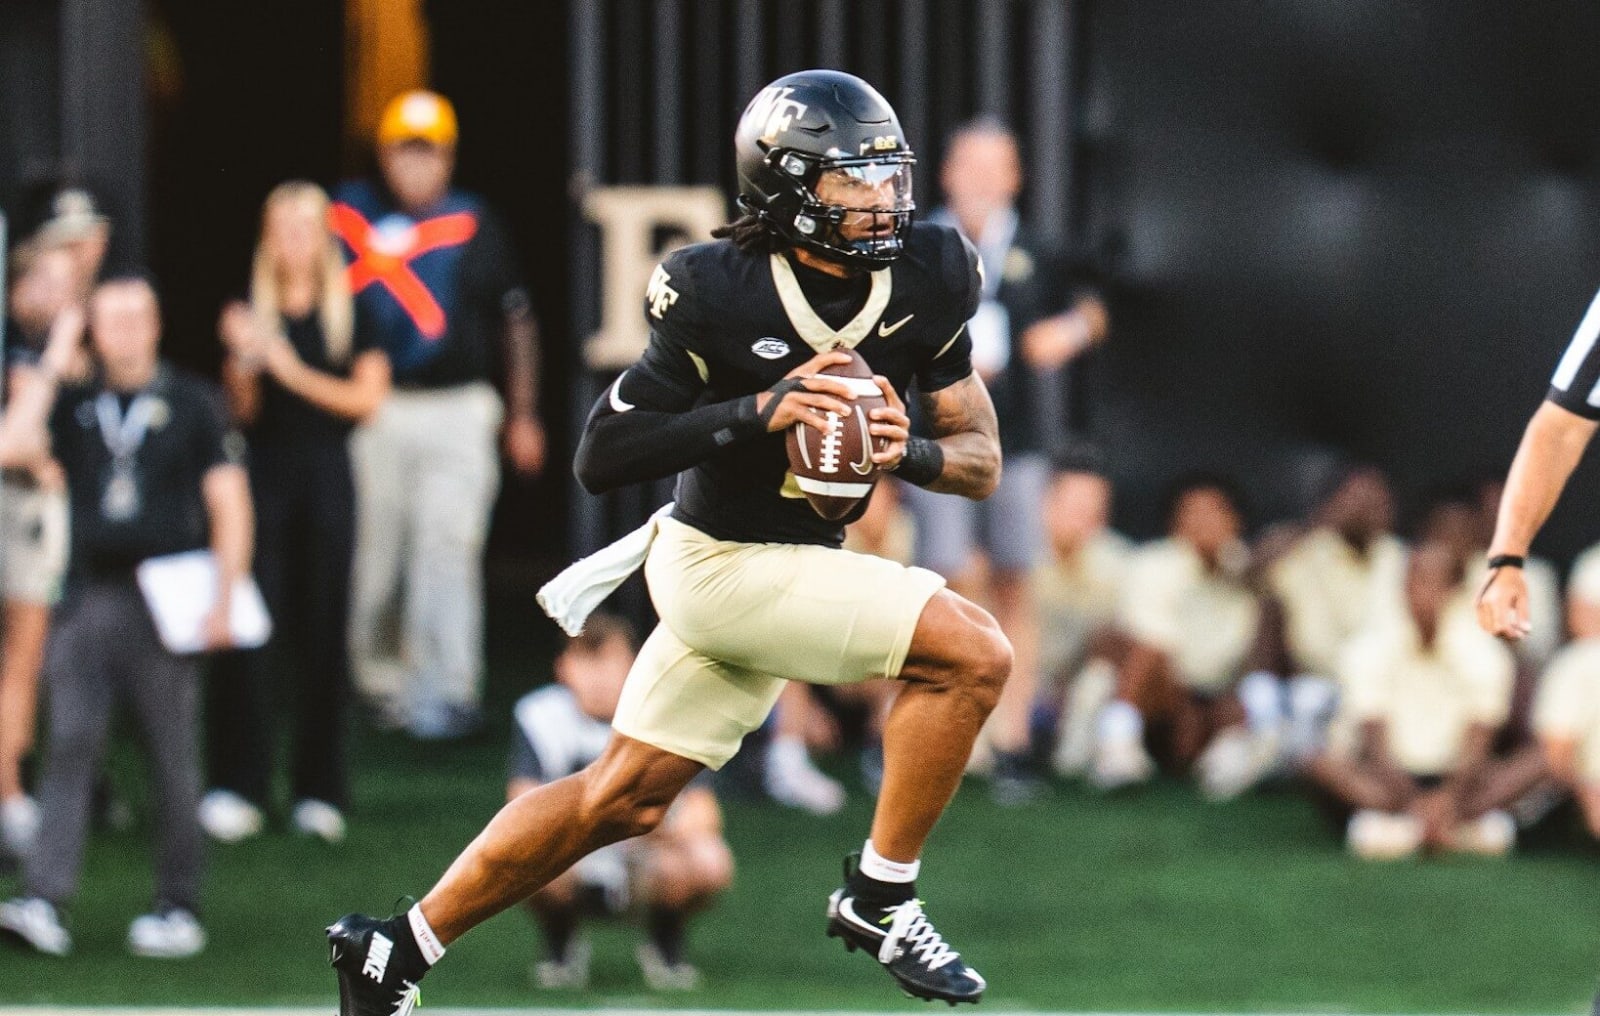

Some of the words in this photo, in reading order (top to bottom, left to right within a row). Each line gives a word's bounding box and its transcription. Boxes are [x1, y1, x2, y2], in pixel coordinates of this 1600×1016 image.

[740, 86, 808, 145] WF
[646, 264, 679, 320] WF
[361, 930, 394, 984] NIKE
